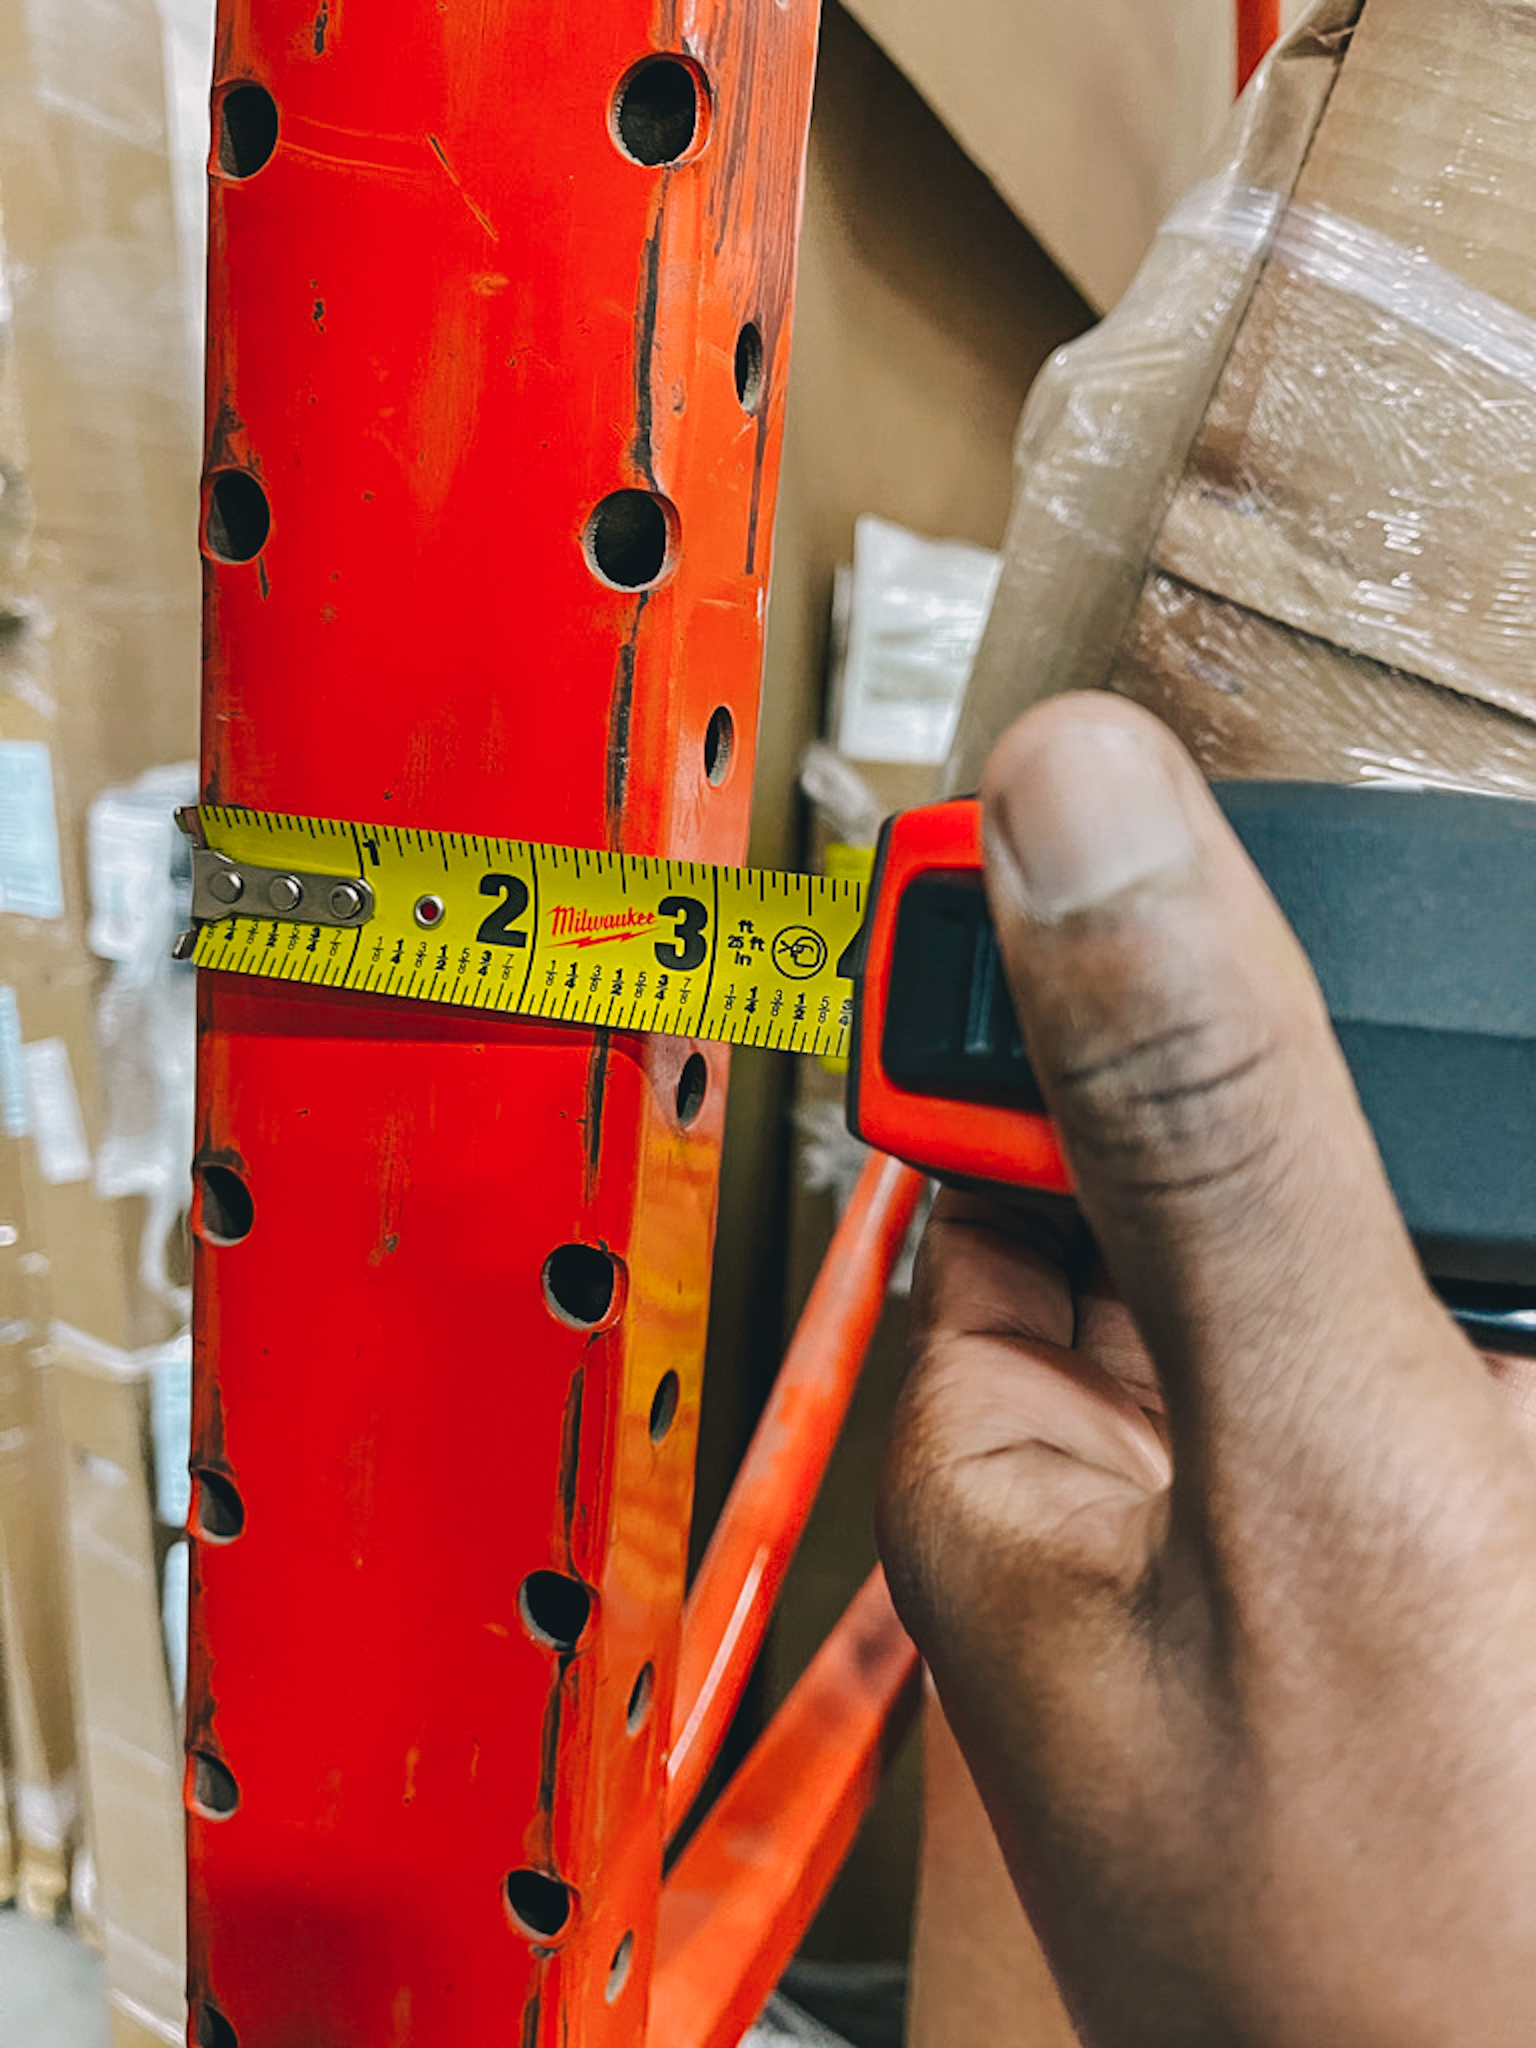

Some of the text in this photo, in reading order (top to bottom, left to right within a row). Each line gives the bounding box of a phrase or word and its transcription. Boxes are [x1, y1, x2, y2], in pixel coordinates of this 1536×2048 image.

[362, 839, 380, 866] 1
[476, 873, 528, 948] 2
[547, 904, 657, 937] Milwaukee
[654, 896, 708, 970] 3
